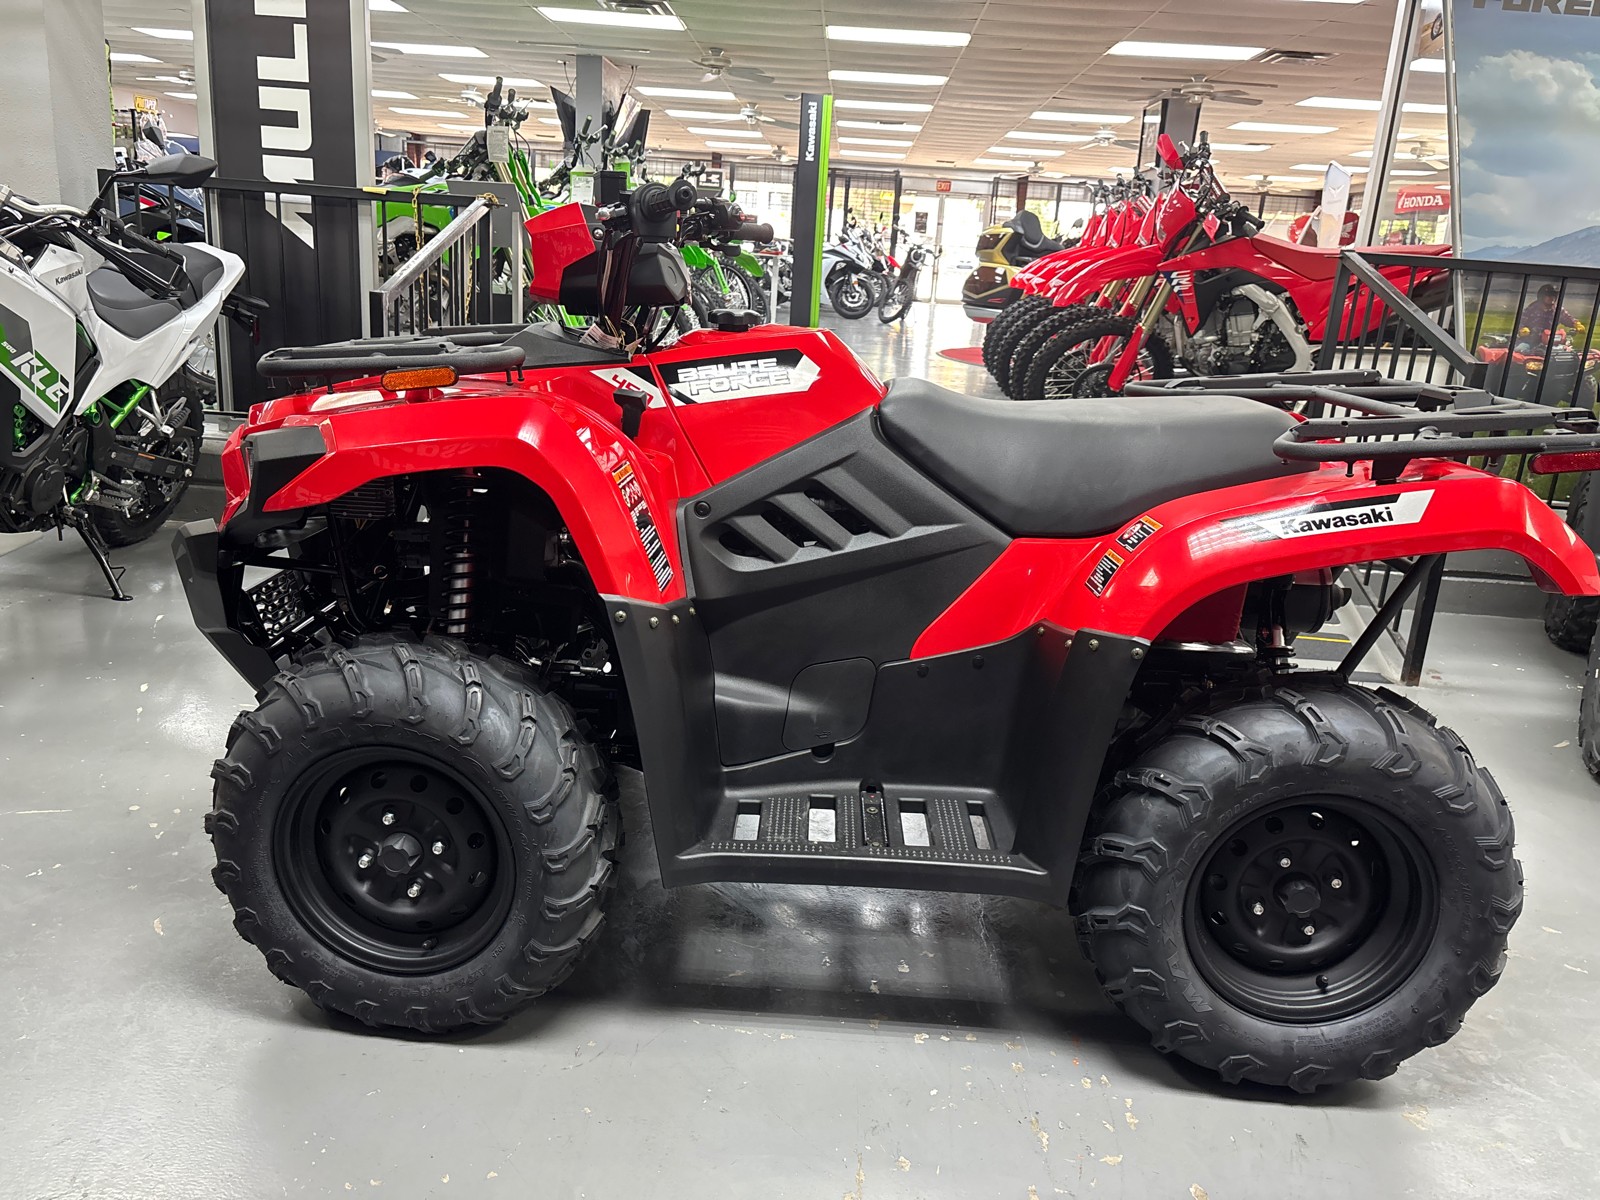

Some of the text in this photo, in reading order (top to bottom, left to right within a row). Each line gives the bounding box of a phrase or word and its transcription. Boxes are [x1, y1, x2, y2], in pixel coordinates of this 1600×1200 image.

[805, 101, 818, 162] Kawasaki
[937, 182, 950, 191] EXIT
[1403, 195, 1444, 209] HONDA
[55, 266, 84, 286] Kawasaki
[1170, 270, 1193, 293] CRF
[1, 341, 17, 354] 500
[677, 357, 778, 382] BRUTE
[689, 371, 791, 396] FORCE
[1280, 506, 1395, 535] Kawasaki
[1161, 832, 1213, 1013] MAXXIS
